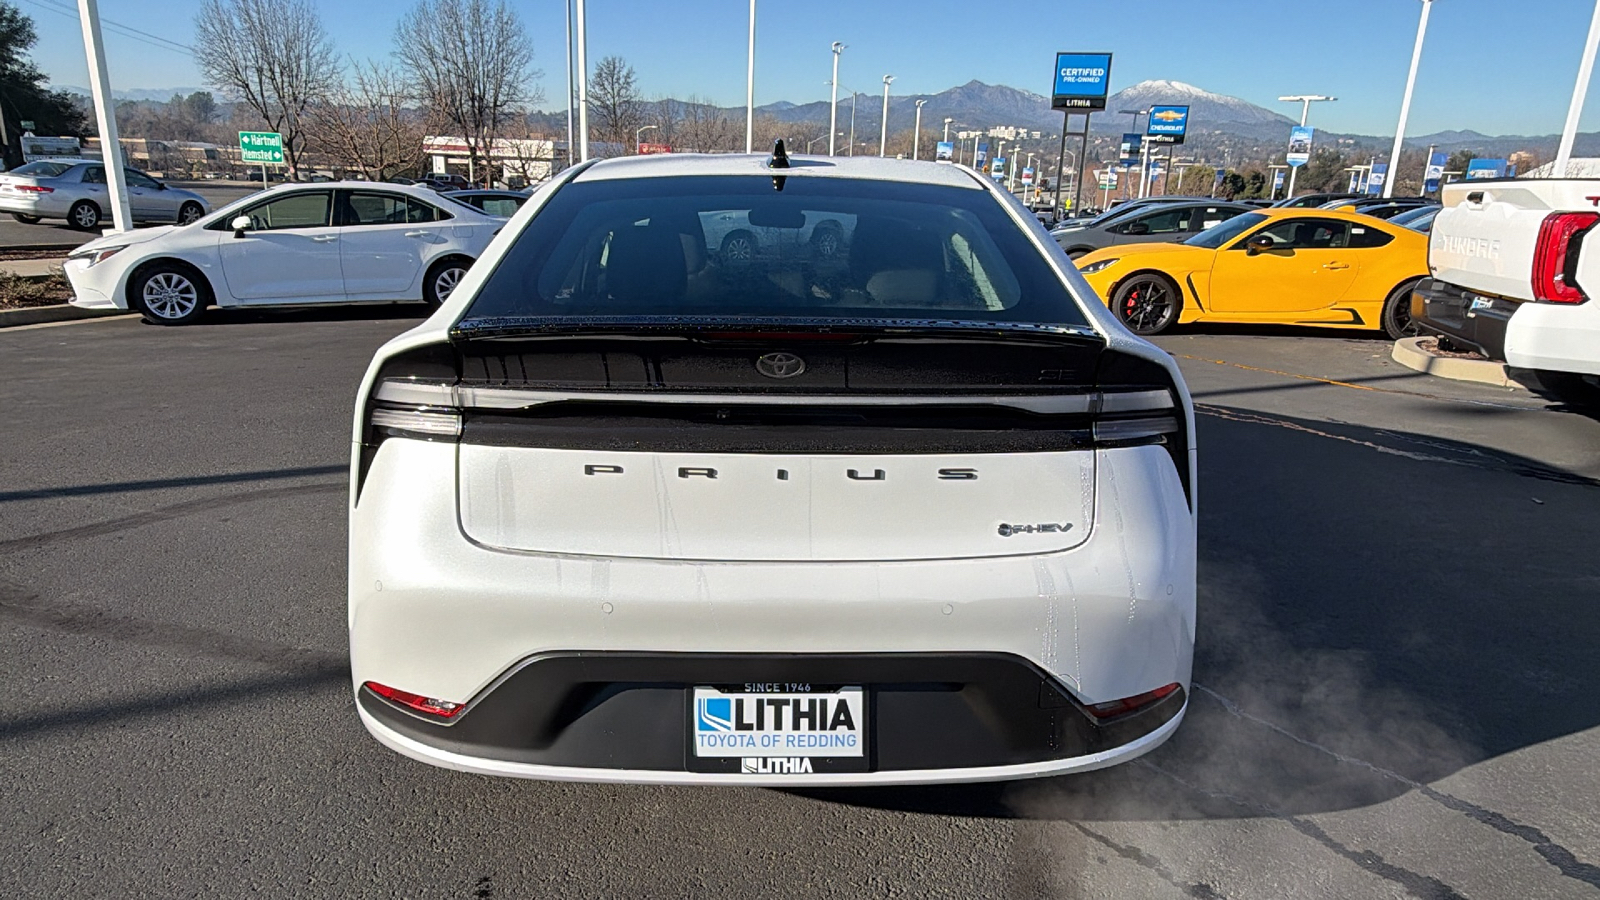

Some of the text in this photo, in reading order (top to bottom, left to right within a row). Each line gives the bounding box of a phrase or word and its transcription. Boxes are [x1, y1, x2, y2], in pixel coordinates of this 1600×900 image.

[1060, 67, 1105, 77] CERTIFIED
[1066, 99, 1091, 107] LITHIA
[250, 134, 280, 147] Hartnell
[242, 148, 273, 161] Hemsted
[1443, 234, 1500, 260] TUNDRA
[584, 464, 979, 481] PRIUS
[744, 682, 811, 693] SINCE 1946
[734, 698, 856, 731] LITHIA
[698, 734, 857, 748] TOYOTA OF REDDING
[757, 757, 813, 773] LITHIA
